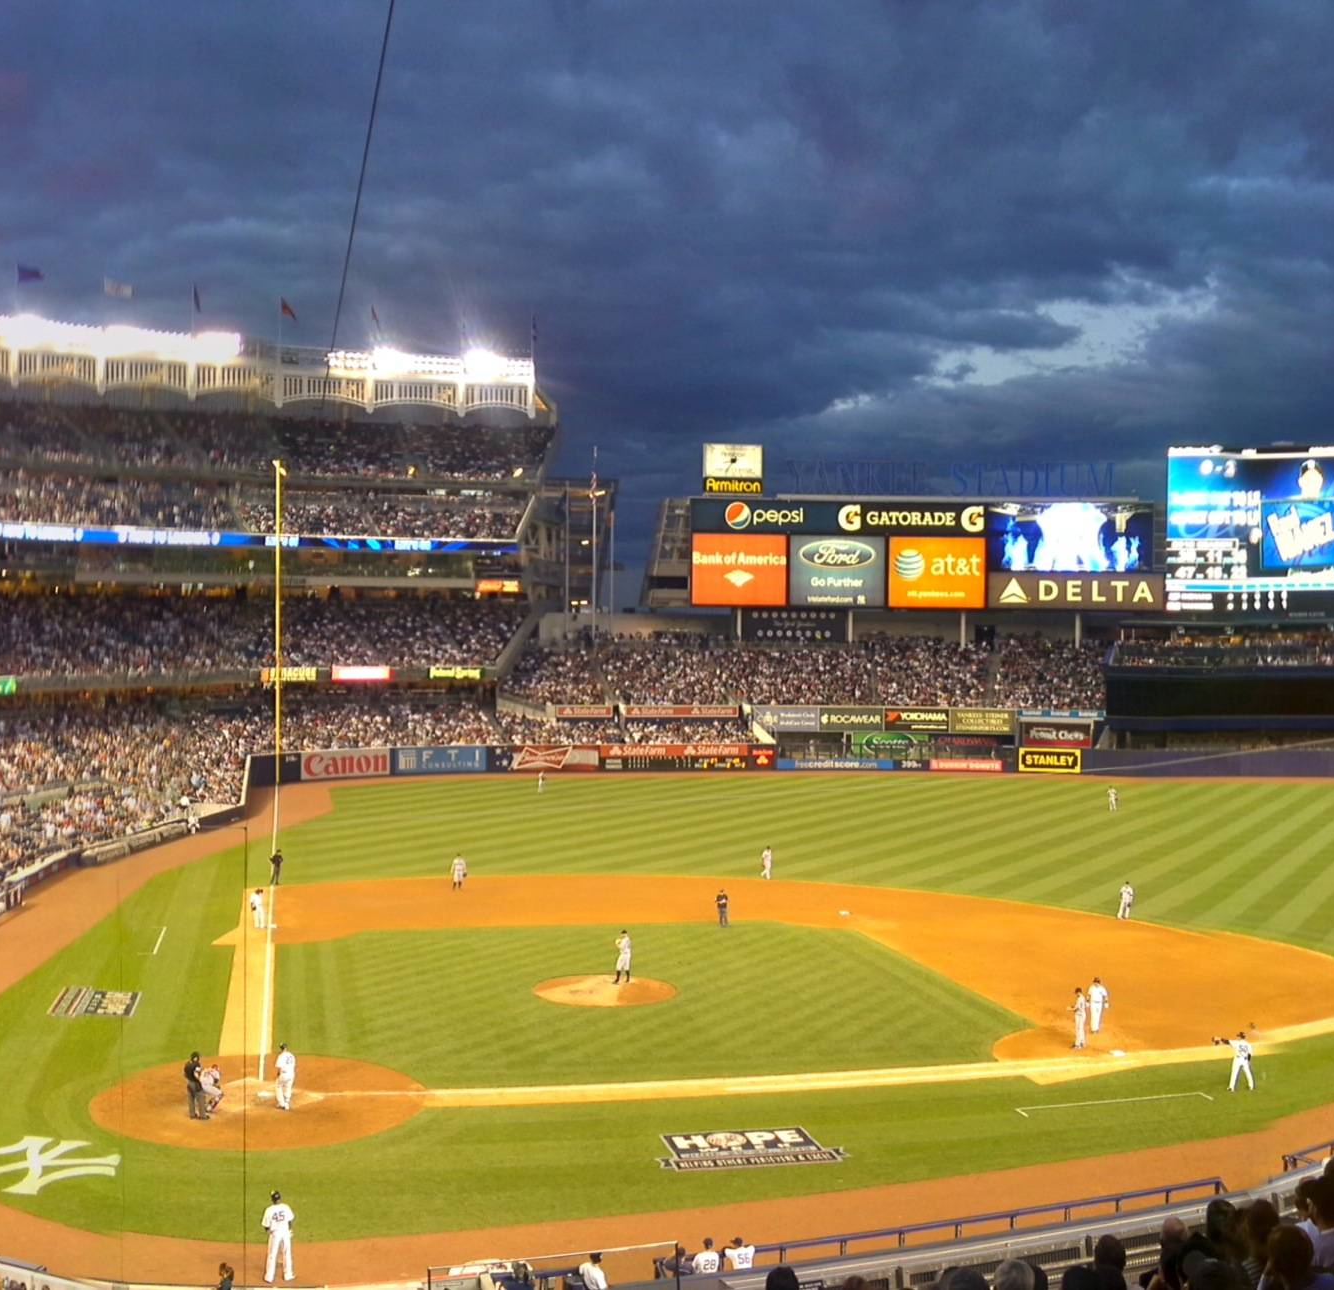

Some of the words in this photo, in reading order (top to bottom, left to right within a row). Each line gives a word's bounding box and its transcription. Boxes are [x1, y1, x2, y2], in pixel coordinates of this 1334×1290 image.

[706, 478, 761, 493] Armitron
[786, 459, 926, 496] YANKEE
[950, 460, 1114, 497] STADIUM
[753, 507, 804, 526] pepsi
[866, 512, 956, 527] GATORADE
[692, 551, 723, 565] Bank
[724, 551, 738, 565] of
[738, 552, 787, 566] America
[814, 543, 861, 565] Ford
[931, 555, 981, 577] at&t
[811, 576, 826, 587] Go
[827, 576, 863, 587] Further
[1038, 580, 1153, 603] DELTA
[830, 715, 881, 724] ROCAWEAR
[900, 712, 947, 721] YOKOHAMA
[303, 753, 388, 778] Canon
[1025, 754, 1074, 766] STANLEY
[272, 1210, 286, 1222] 45
[703, 1258, 717, 1271] 28
[737, 1253, 751, 1265] 56
